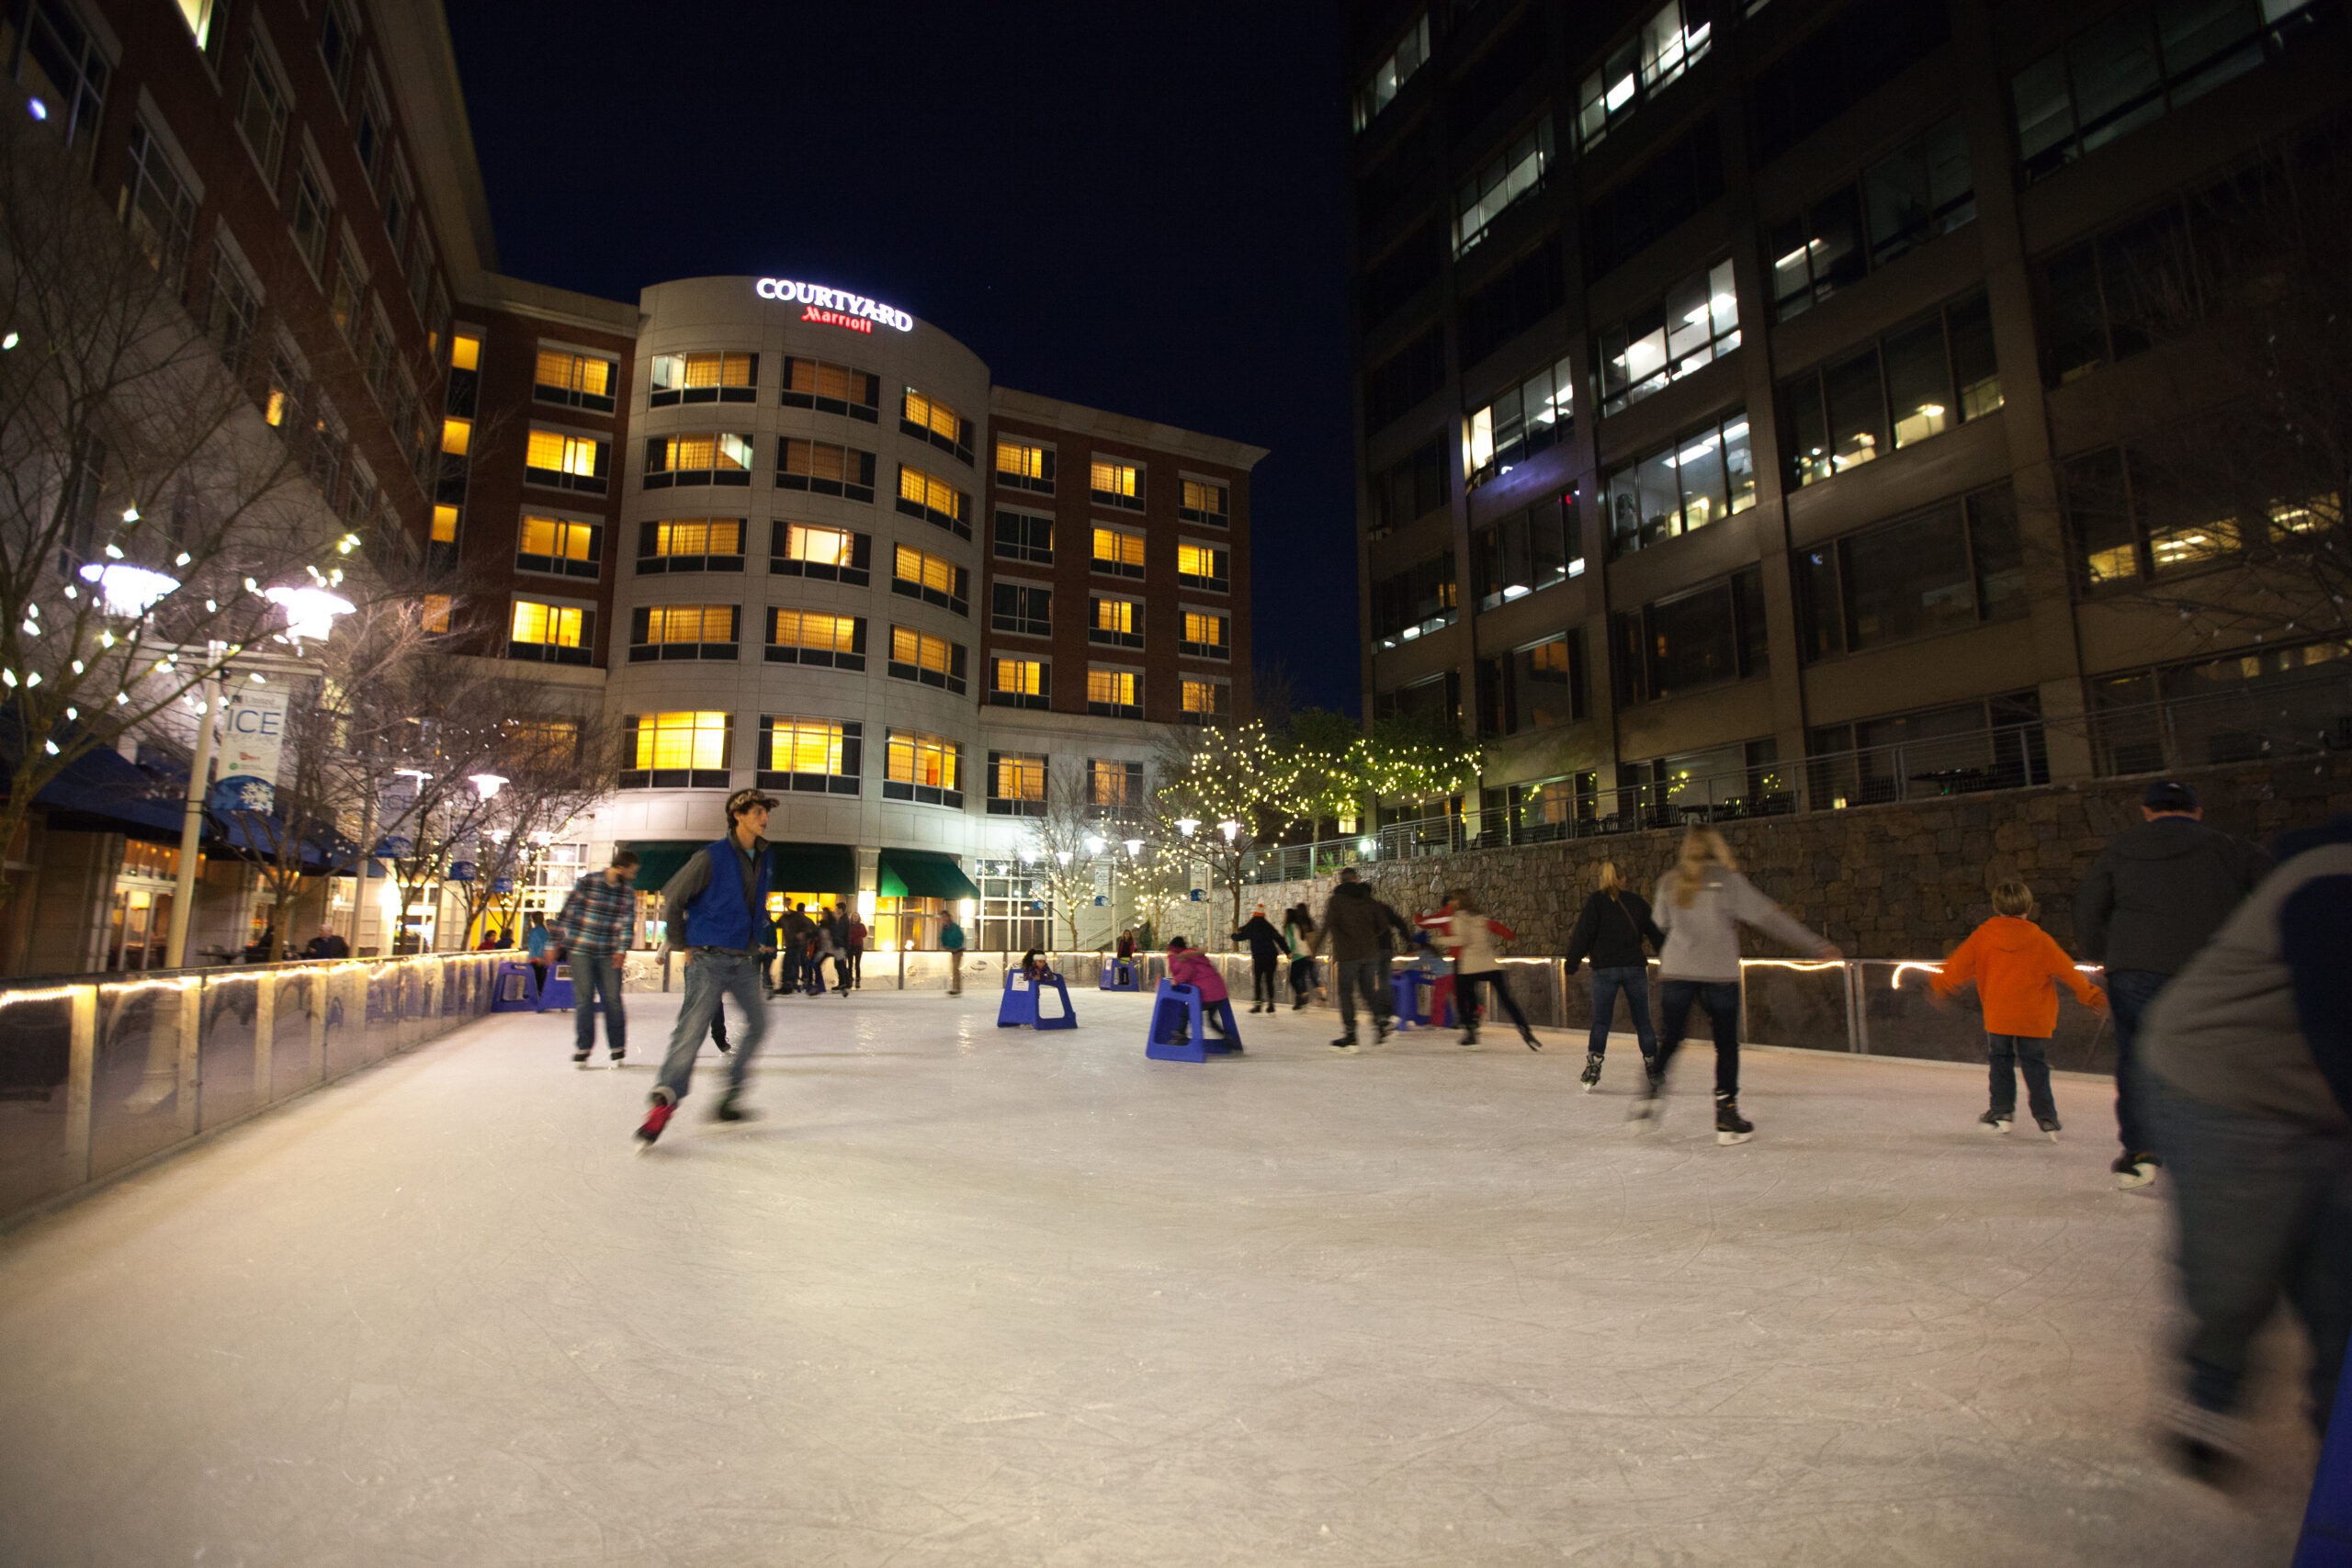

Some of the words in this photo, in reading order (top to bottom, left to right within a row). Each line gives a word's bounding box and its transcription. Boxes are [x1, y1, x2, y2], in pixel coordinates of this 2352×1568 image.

[756, 277, 914, 333] COURTYARD
[801, 305, 872, 334] Marriott
[227, 709, 281, 735] ICE
